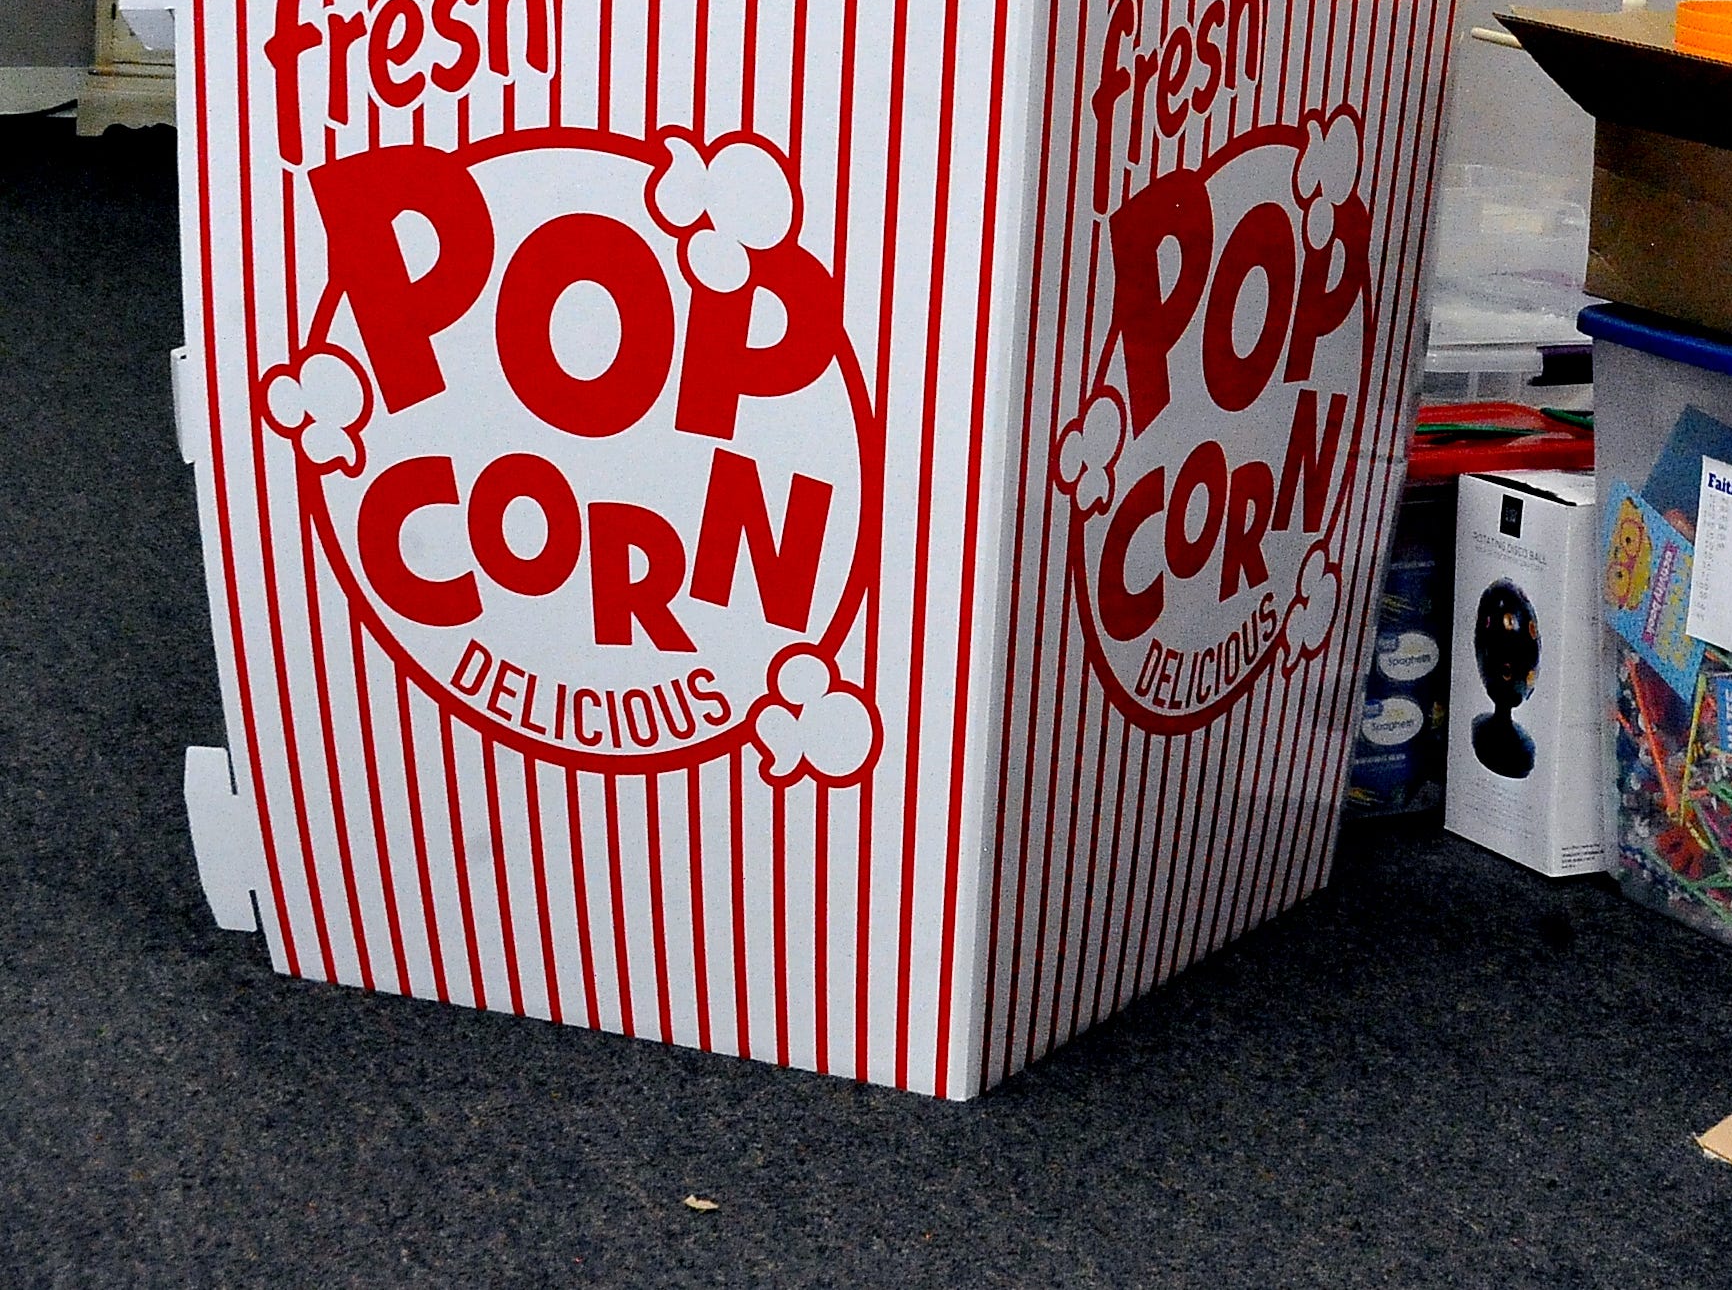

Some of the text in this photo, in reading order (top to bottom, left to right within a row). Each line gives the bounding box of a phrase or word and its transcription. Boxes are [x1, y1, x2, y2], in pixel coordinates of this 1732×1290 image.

[308, 144, 844, 441] POP
[1109, 168, 1370, 442] POP
[357, 447, 833, 652] CORN
[1097, 390, 1347, 641] CORN
[450, 638, 733, 749] DELICIOUS
[1134, 591, 1280, 710] DELICIOUS
